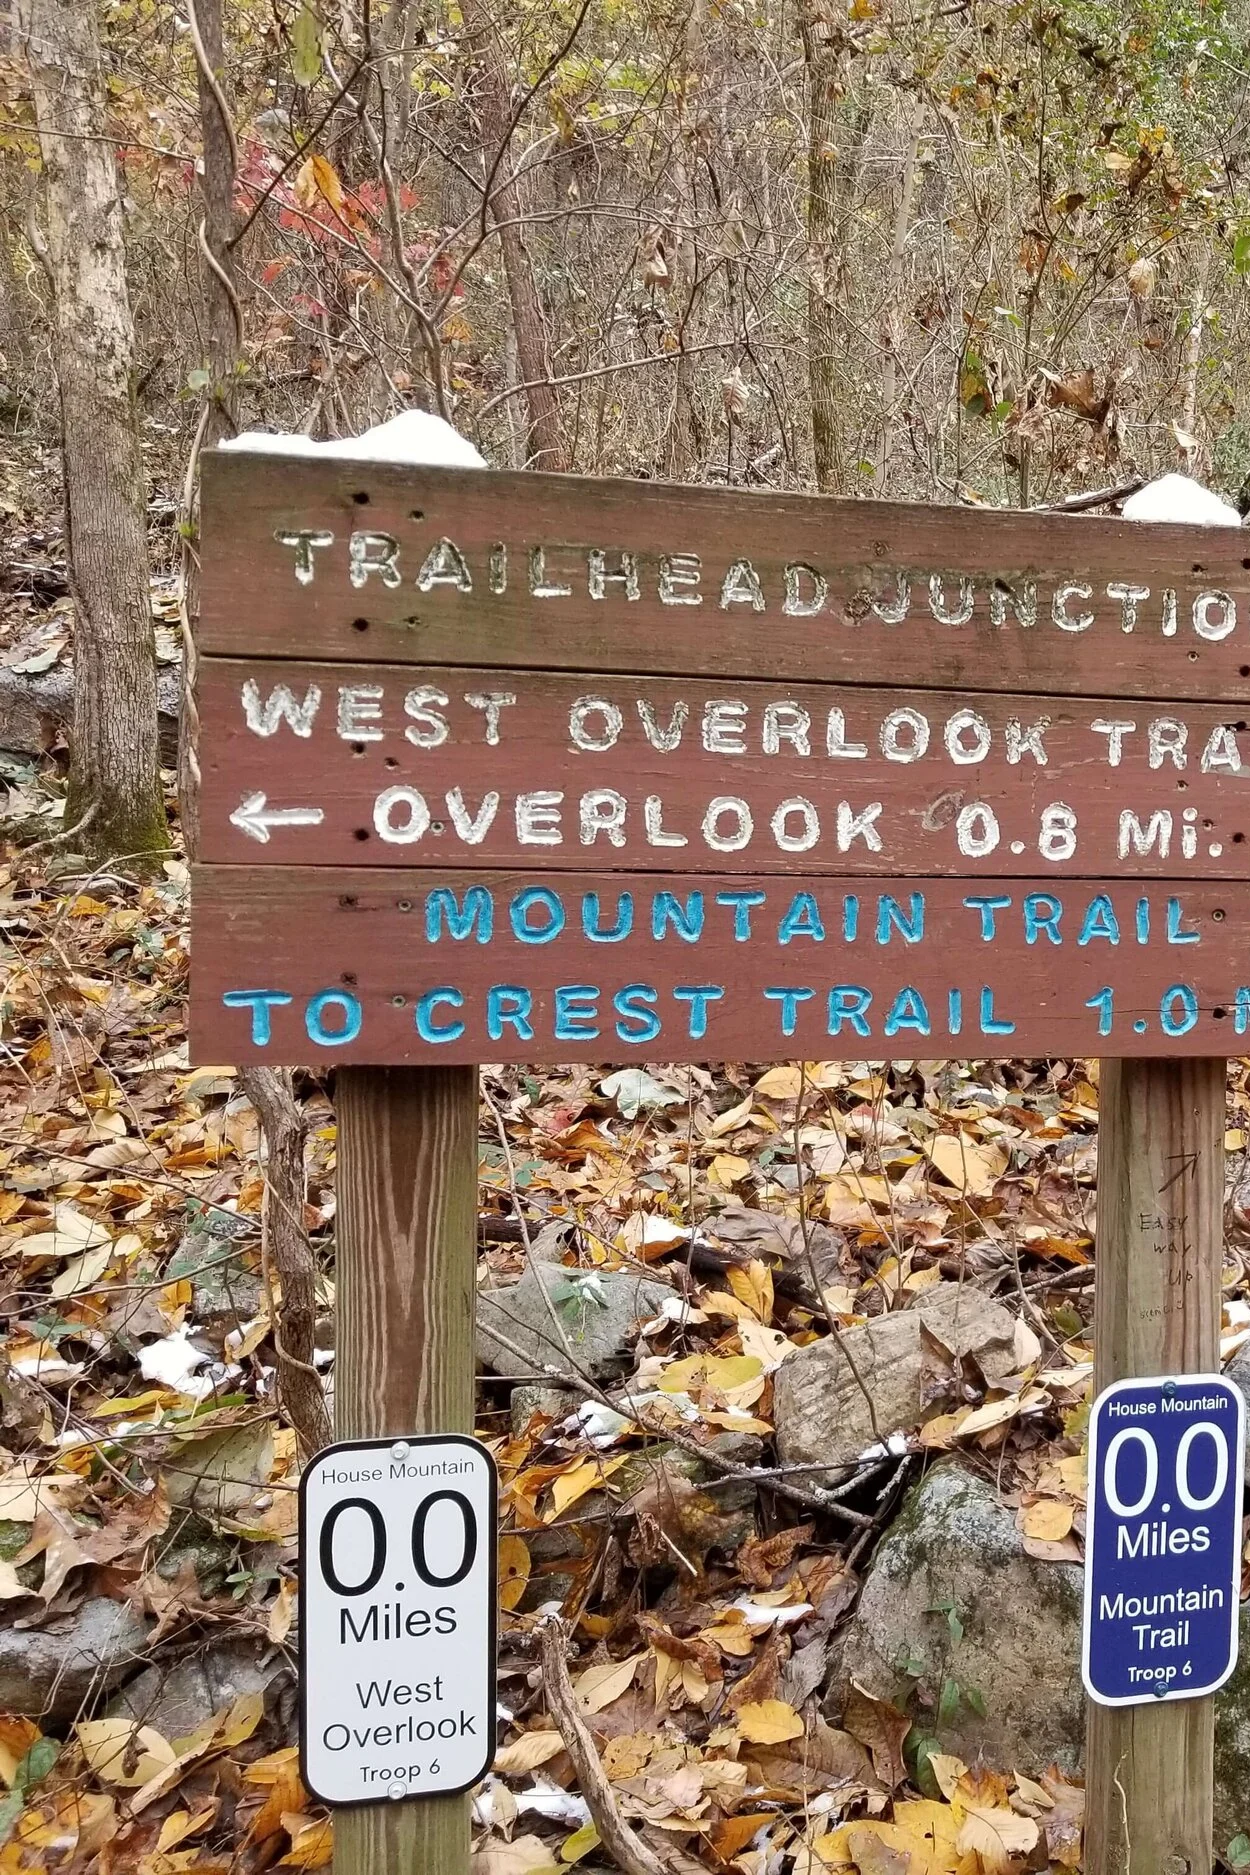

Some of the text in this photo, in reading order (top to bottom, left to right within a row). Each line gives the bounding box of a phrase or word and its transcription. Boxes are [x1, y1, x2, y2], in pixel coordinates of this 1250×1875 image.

[274, 527, 830, 618] TRAILHEAD
[240, 677, 516, 750] WEST
[568, 695, 1054, 765] OVERLOOK
[372, 785, 884, 853] OVERLOOK
[955, 800, 1078, 861] 0.8
[425, 884, 1201, 946] MOUNTAIN TRAIL
[222, 987, 363, 1046] TO
[415, 981, 726, 1045] CREST
[763, 984, 1016, 1037] TRAIL
[1085, 984, 1199, 1037] 1.0
[1108, 1394, 1229, 1417] House Mountain
[321, 1458, 476, 1486] House Mountain
[1103, 1421, 1229, 1518] 0.0
[319, 1489, 478, 1597] 0.0
[1116, 1521, 1211, 1560] Miles
[339, 1602, 458, 1645] Miles
[1099, 1584, 1224, 1621] Mountain
[1132, 1620, 1190, 1651] Trail
[355, 1674, 444, 1710] West
[1127, 1660, 1193, 1684] Troop 6
[322, 1709, 477, 1752] Overlook
[359, 1757, 441, 1784] Troop 6
